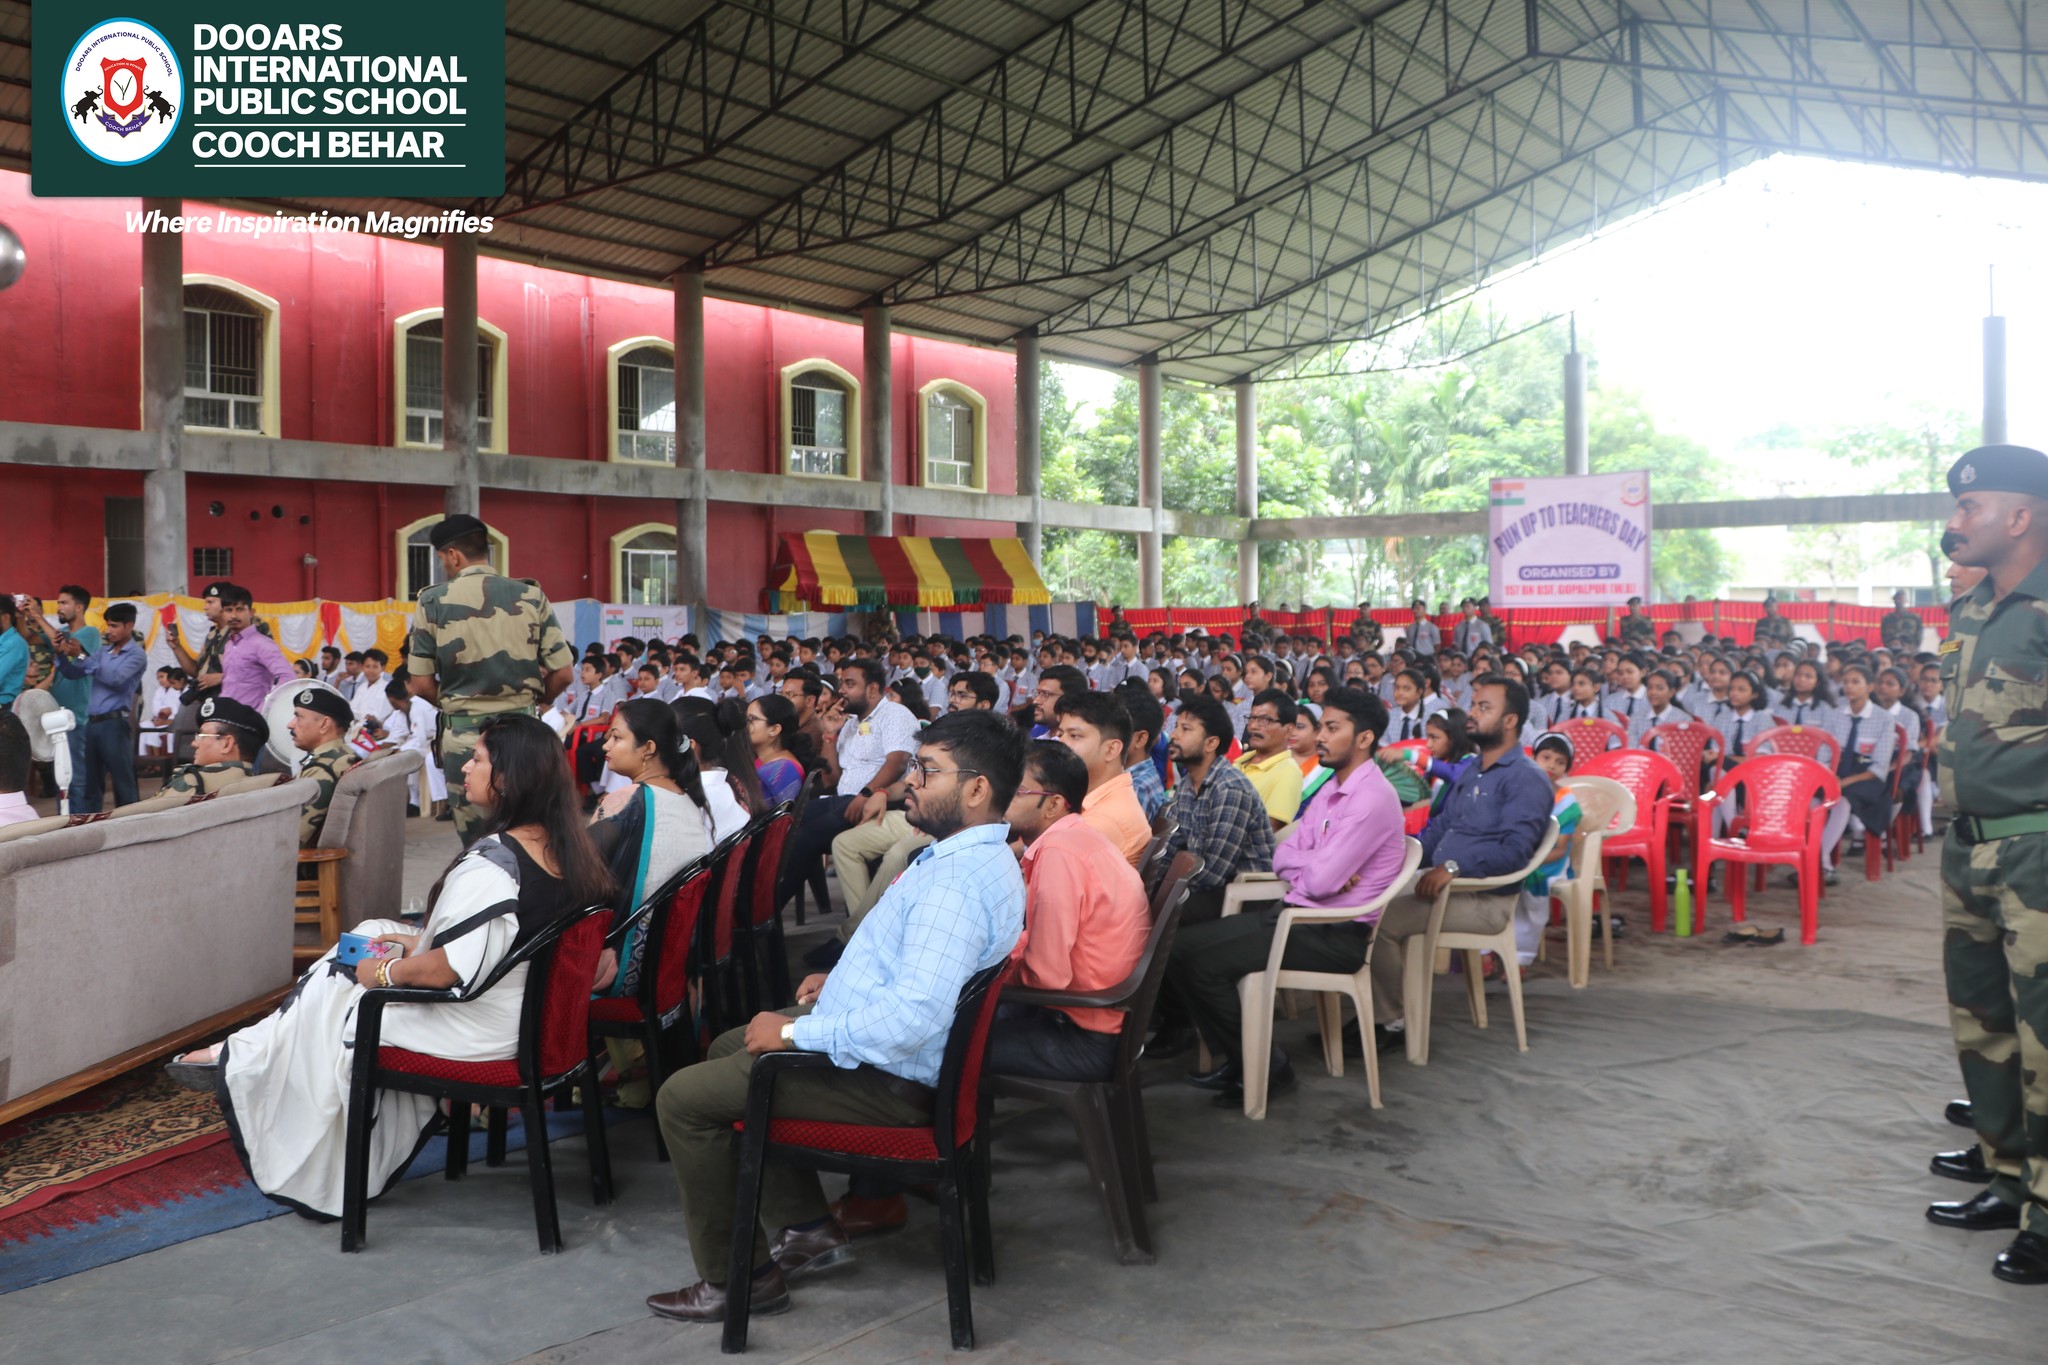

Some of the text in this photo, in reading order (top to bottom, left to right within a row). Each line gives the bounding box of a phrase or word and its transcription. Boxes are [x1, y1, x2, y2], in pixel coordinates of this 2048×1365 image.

[1494, 502, 1648, 557] RUN UP TO TEACHERS DAY
[1521, 566, 1617, 579] ORGANISED BY
